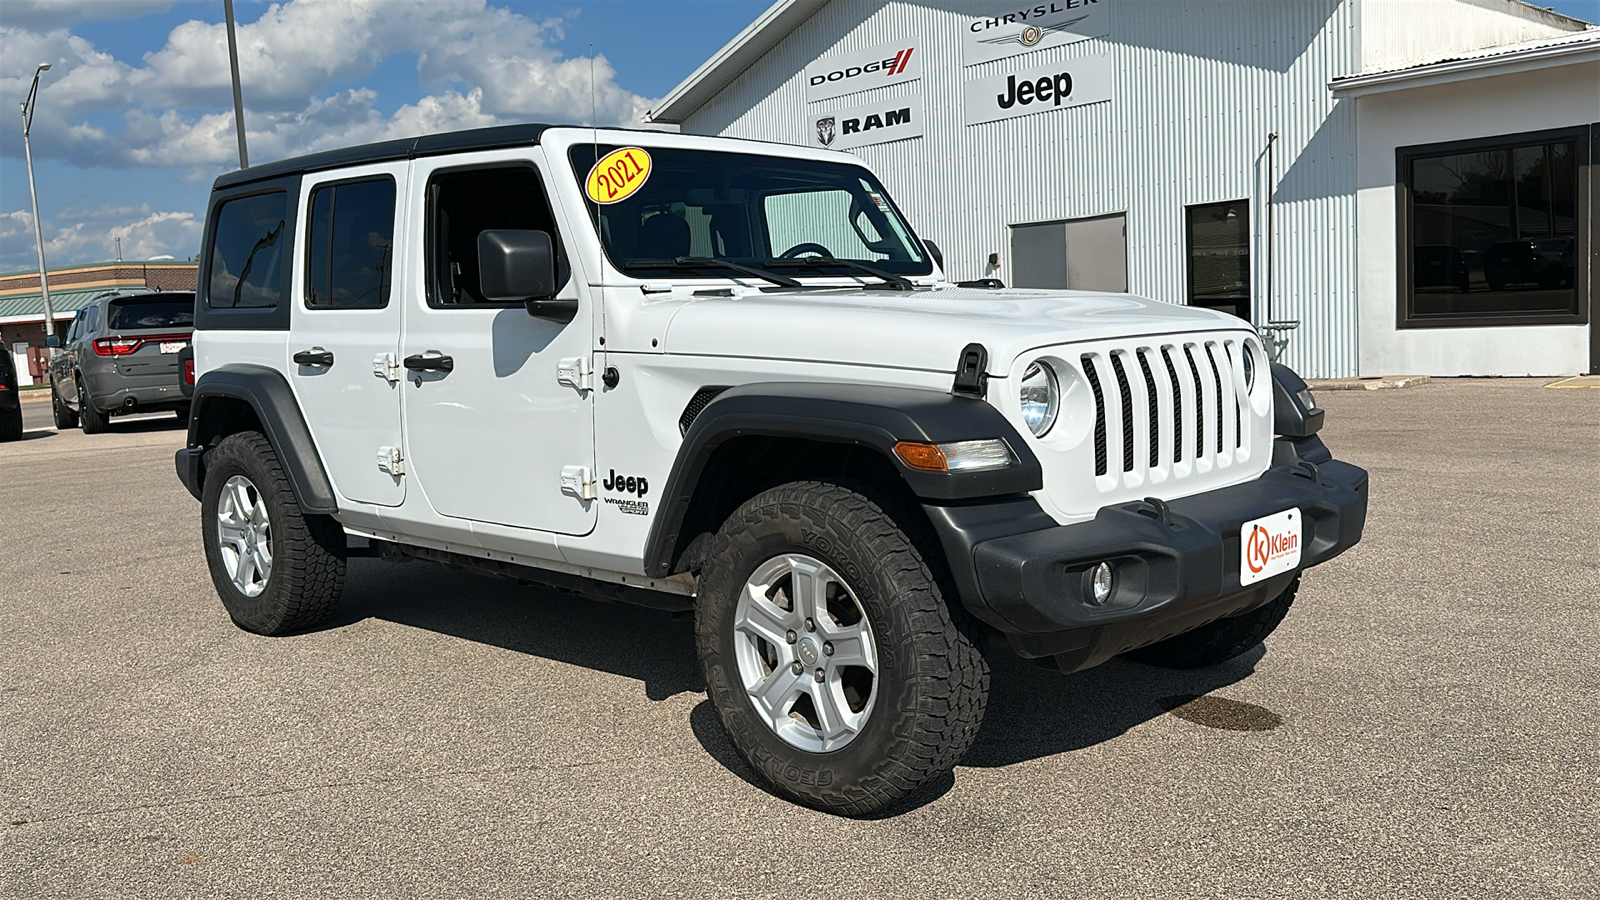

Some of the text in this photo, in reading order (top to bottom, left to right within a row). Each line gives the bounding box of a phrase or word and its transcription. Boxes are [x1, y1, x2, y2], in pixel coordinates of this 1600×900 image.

[810, 57, 898, 87] DODGE
[997, 71, 1073, 109] Jeep
[842, 107, 911, 136] RAM
[597, 151, 644, 199] 2021
[603, 468, 649, 498] Jeep
[603, 497, 649, 508] WRANGLER
[1271, 530, 1298, 555] Klein
[800, 528, 895, 670] YOKOHAMA
[710, 665, 834, 788] GEOLANDAR
